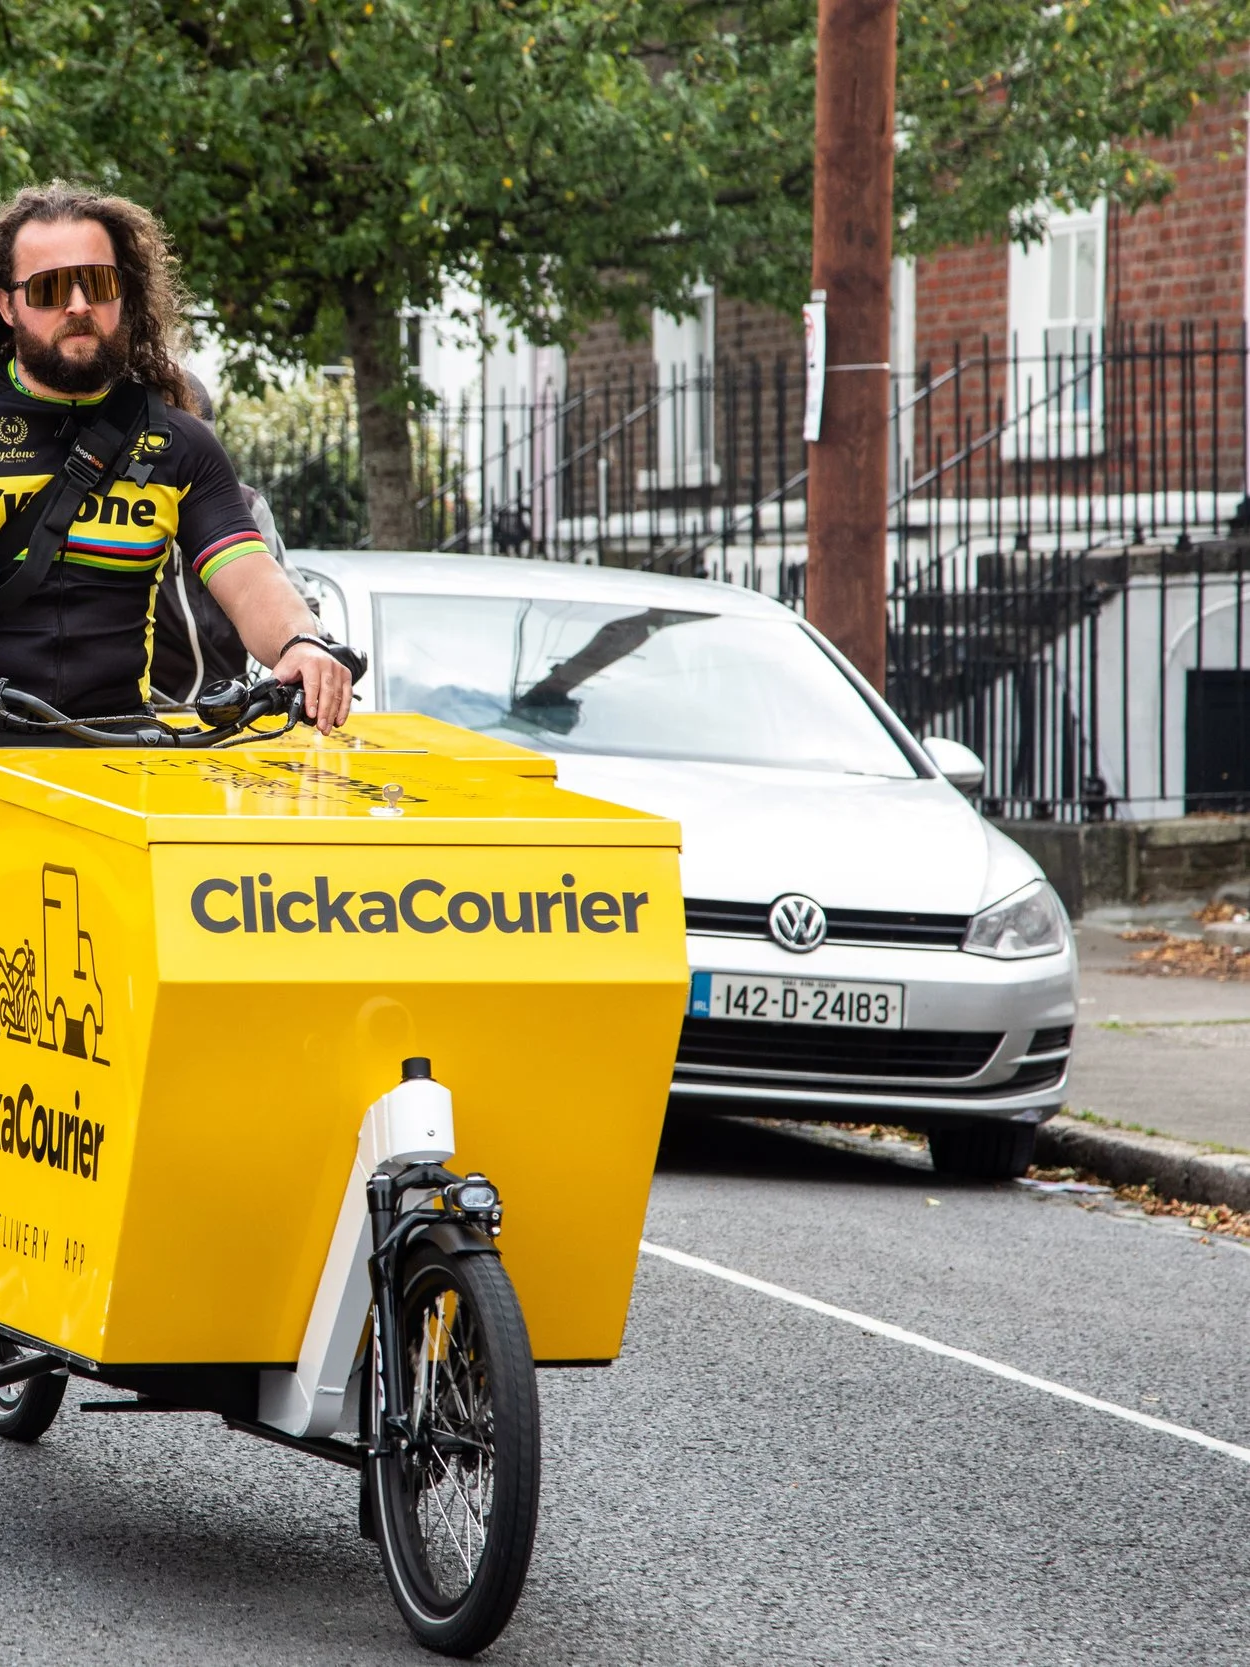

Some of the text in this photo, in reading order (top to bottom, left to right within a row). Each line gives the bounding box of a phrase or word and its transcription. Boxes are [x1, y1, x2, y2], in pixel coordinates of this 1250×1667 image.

[4, 424, 19, 435] 30
[190, 872, 649, 934] ClickaCourier
[693, 1001, 709, 1012] IRL
[725, 984, 889, 1024] 142-D-24183
[64, 1237, 86, 1276] APP
